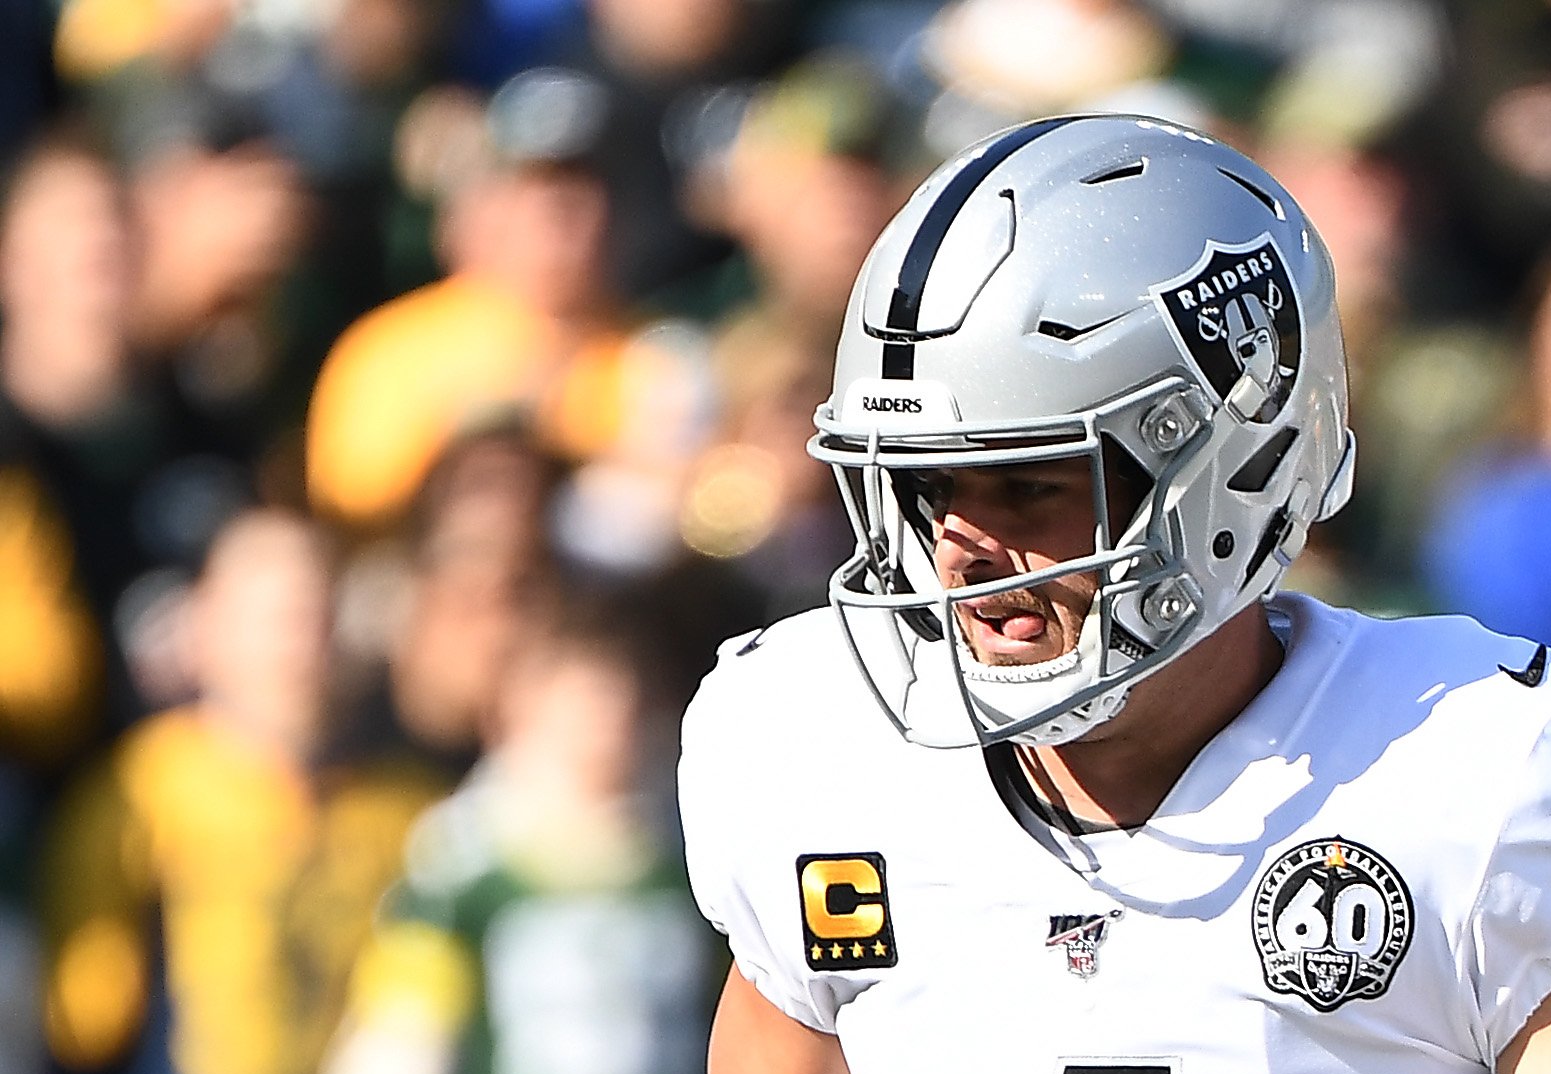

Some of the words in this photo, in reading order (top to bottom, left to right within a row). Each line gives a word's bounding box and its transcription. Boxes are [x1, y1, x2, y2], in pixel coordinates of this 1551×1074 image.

[1177, 251, 1273, 310] RAIDERS
[862, 396, 922, 413] RAIDERS
[801, 858, 886, 940] C
[1276, 878, 1386, 956] 60
